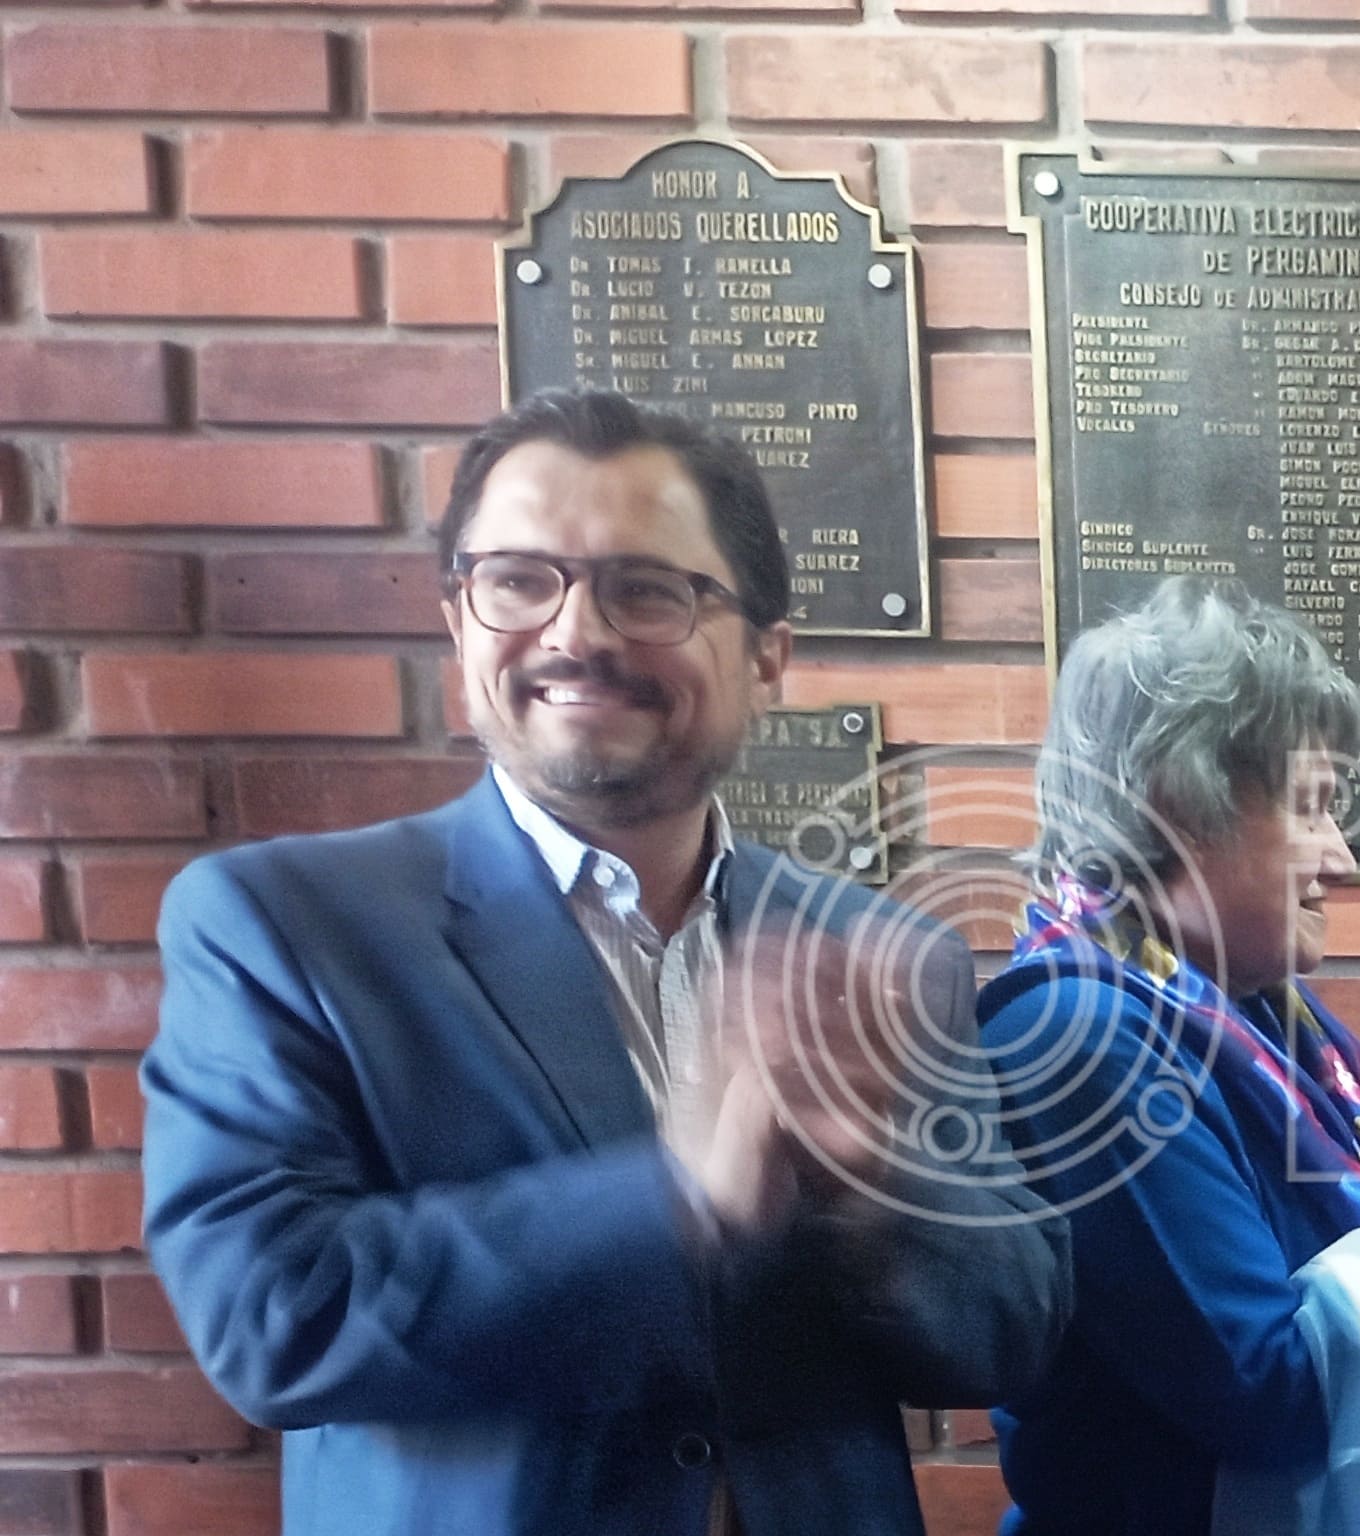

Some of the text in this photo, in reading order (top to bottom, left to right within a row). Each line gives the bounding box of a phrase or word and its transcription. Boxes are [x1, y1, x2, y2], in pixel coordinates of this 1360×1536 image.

[653, 171, 717, 199] HONOR
[571, 211, 839, 243] ASOCIADOS QUERELLADOS
[1086, 202, 1237, 237] COOPERATIVA
[608, 257, 661, 273] TOMAS
[715, 258, 792, 275] RAMELLA
[1204, 249, 1231, 275] DE
[608, 281, 653, 296] LUCIO
[719, 281, 772, 298] TEZON
[1120, 283, 1202, 308] CONSEJO
[1215, 289, 1236, 309] DE
[610, 305, 668, 321] ANIBAL
[610, 329, 818, 348] MIGUEL ARMAS LOPEZ
[612, 354, 670, 369] MIGUEL
[613, 377, 650, 392] LUIS
[712, 403, 785, 419] MANCUSO
[809, 404, 857, 420] PINTO
[1077, 417, 1135, 433] VOCALES
[742, 427, 811, 444] PETRONI
[812, 528, 858, 545] RIERA
[796, 554, 859, 571] SUAREZ
